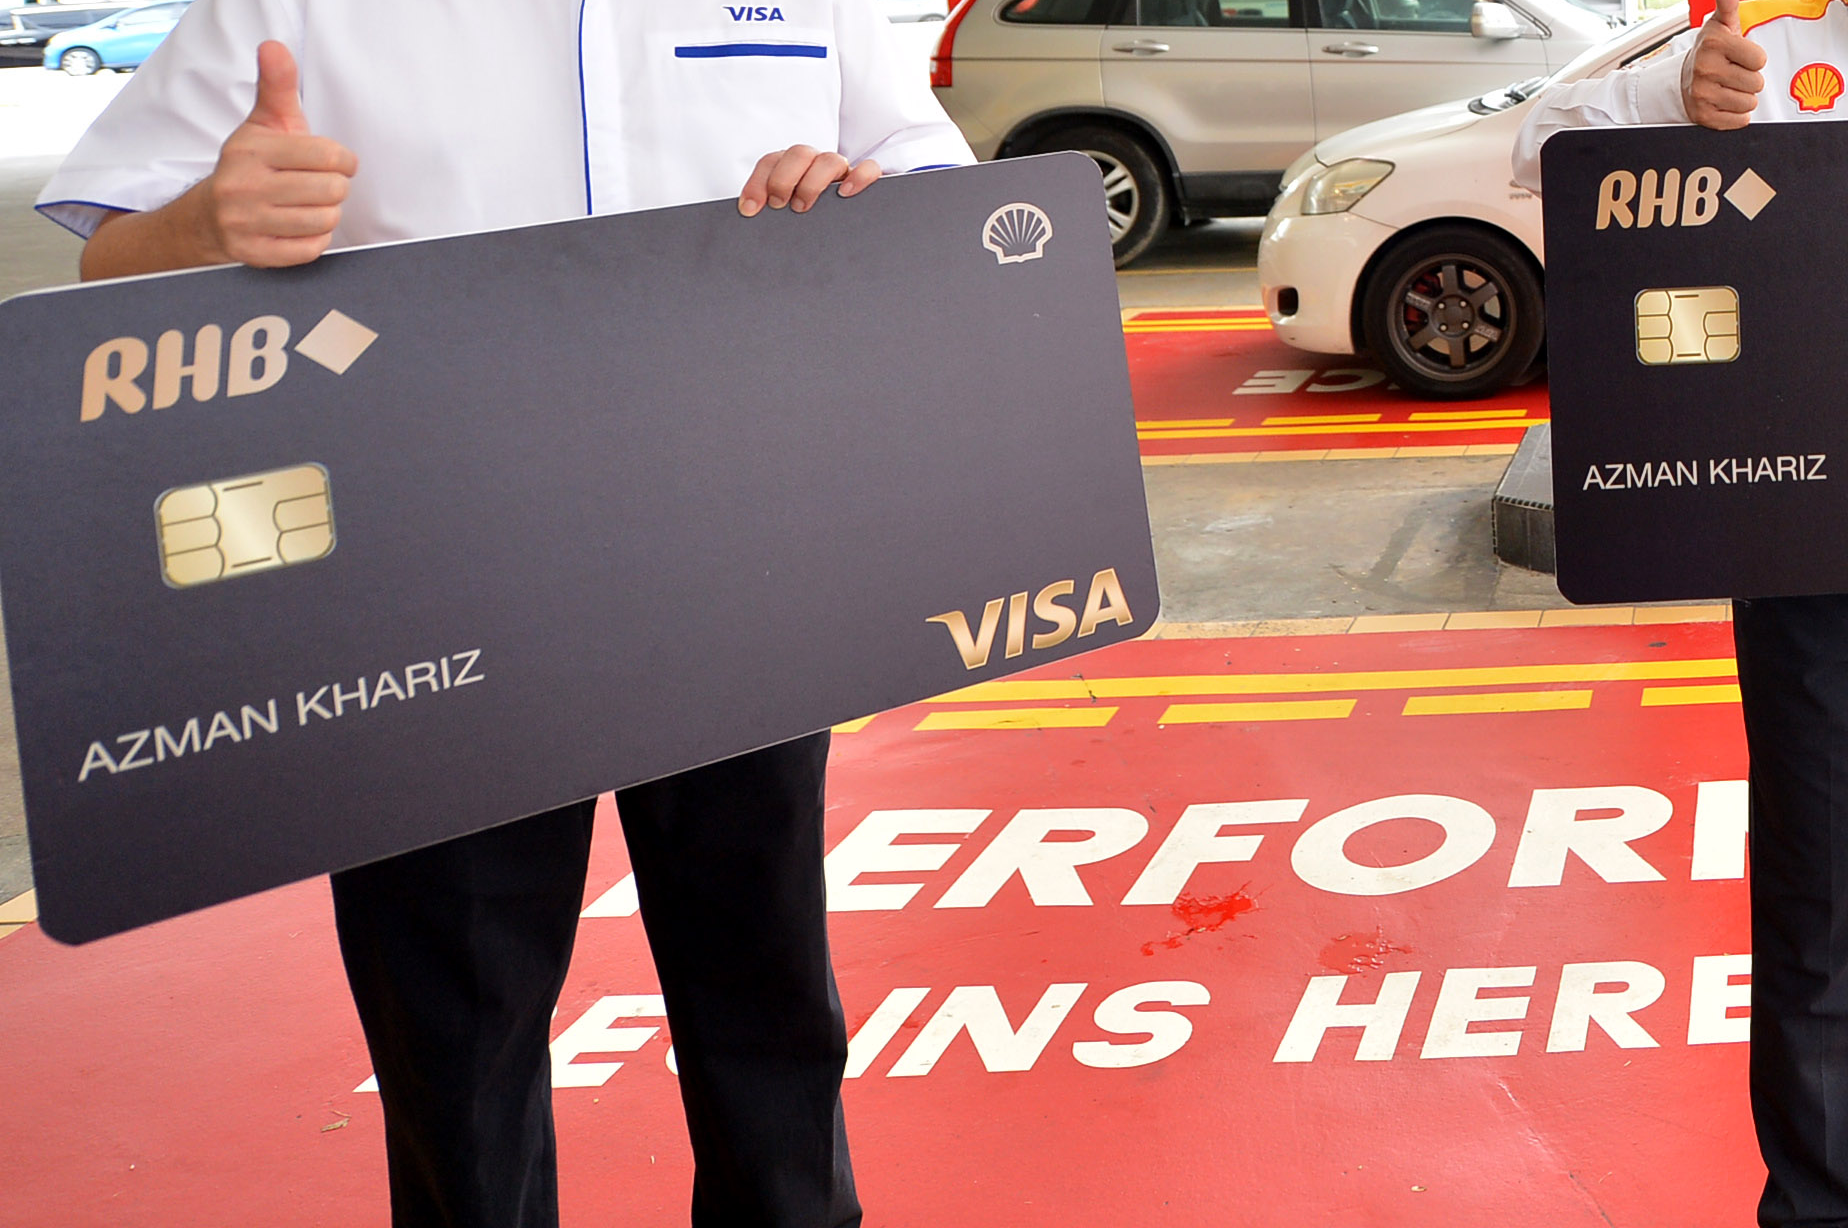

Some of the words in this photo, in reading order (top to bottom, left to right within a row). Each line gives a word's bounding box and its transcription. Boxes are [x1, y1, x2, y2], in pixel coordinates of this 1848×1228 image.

[722, 6, 785, 22] VISA
[1595, 166, 1722, 230] RHB
[80, 314, 292, 422] RHB
[1582, 459, 1698, 491] AZMAN
[1709, 454, 1827, 485] KHARIZ
[925, 567, 1134, 670] VISA
[78, 698, 280, 782] AZMAN
[296, 648, 485, 727] KHARIZ
[1272, 953, 1752, 1064] HERE
